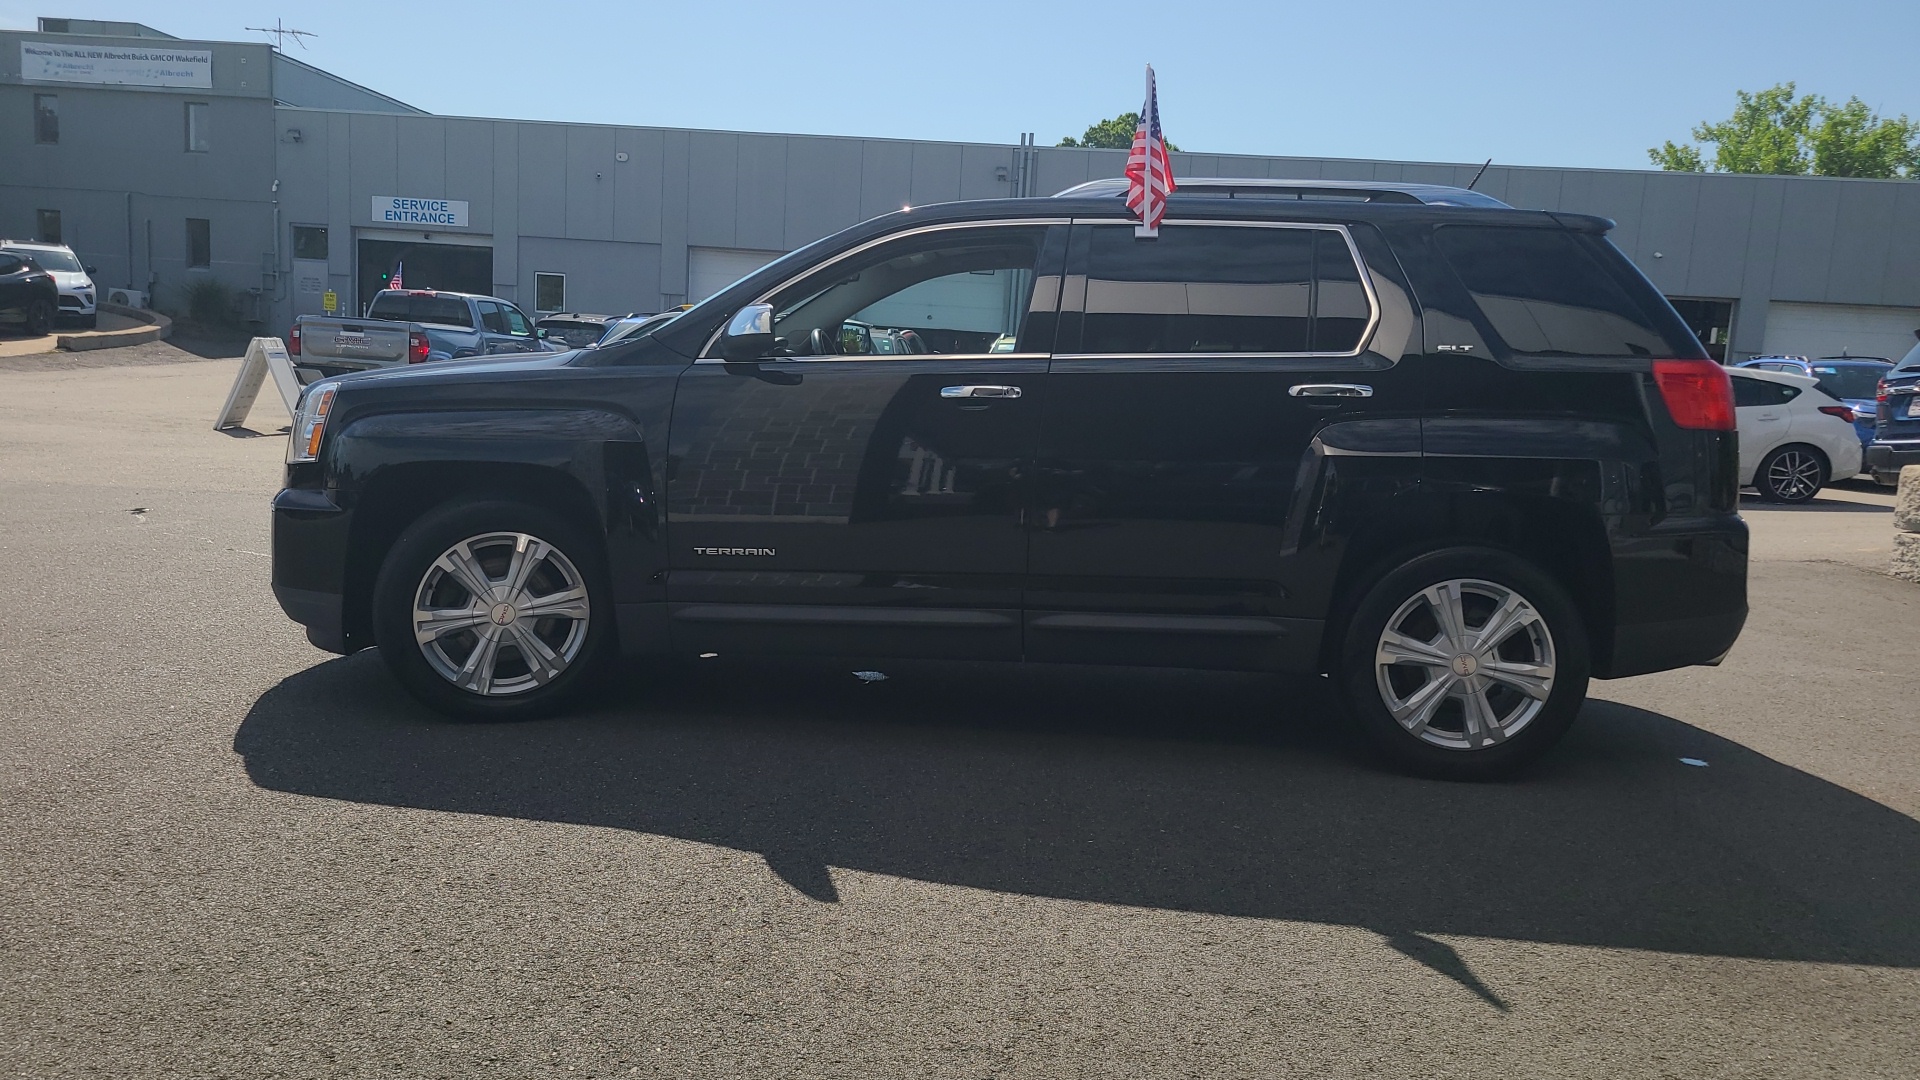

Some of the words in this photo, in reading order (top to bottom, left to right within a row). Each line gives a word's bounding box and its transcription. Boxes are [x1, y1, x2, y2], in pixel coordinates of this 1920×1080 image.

[24, 47, 53, 57] Welcome
[62, 50, 74, 58] The
[87, 51, 102, 59] NEW
[104, 52, 131, 60] Albrecht
[131, 53, 149, 61] Buick
[150, 54, 166, 62] GMC
[176, 55, 208, 63] Wakefield
[160, 69, 193, 77] Albrecht
[393, 199, 448, 212] SERVICE
[385, 210, 455, 224] ENTRANCE
[693, 547, 776, 556] TERRAIN
[498, 605, 509, 624] GMC
